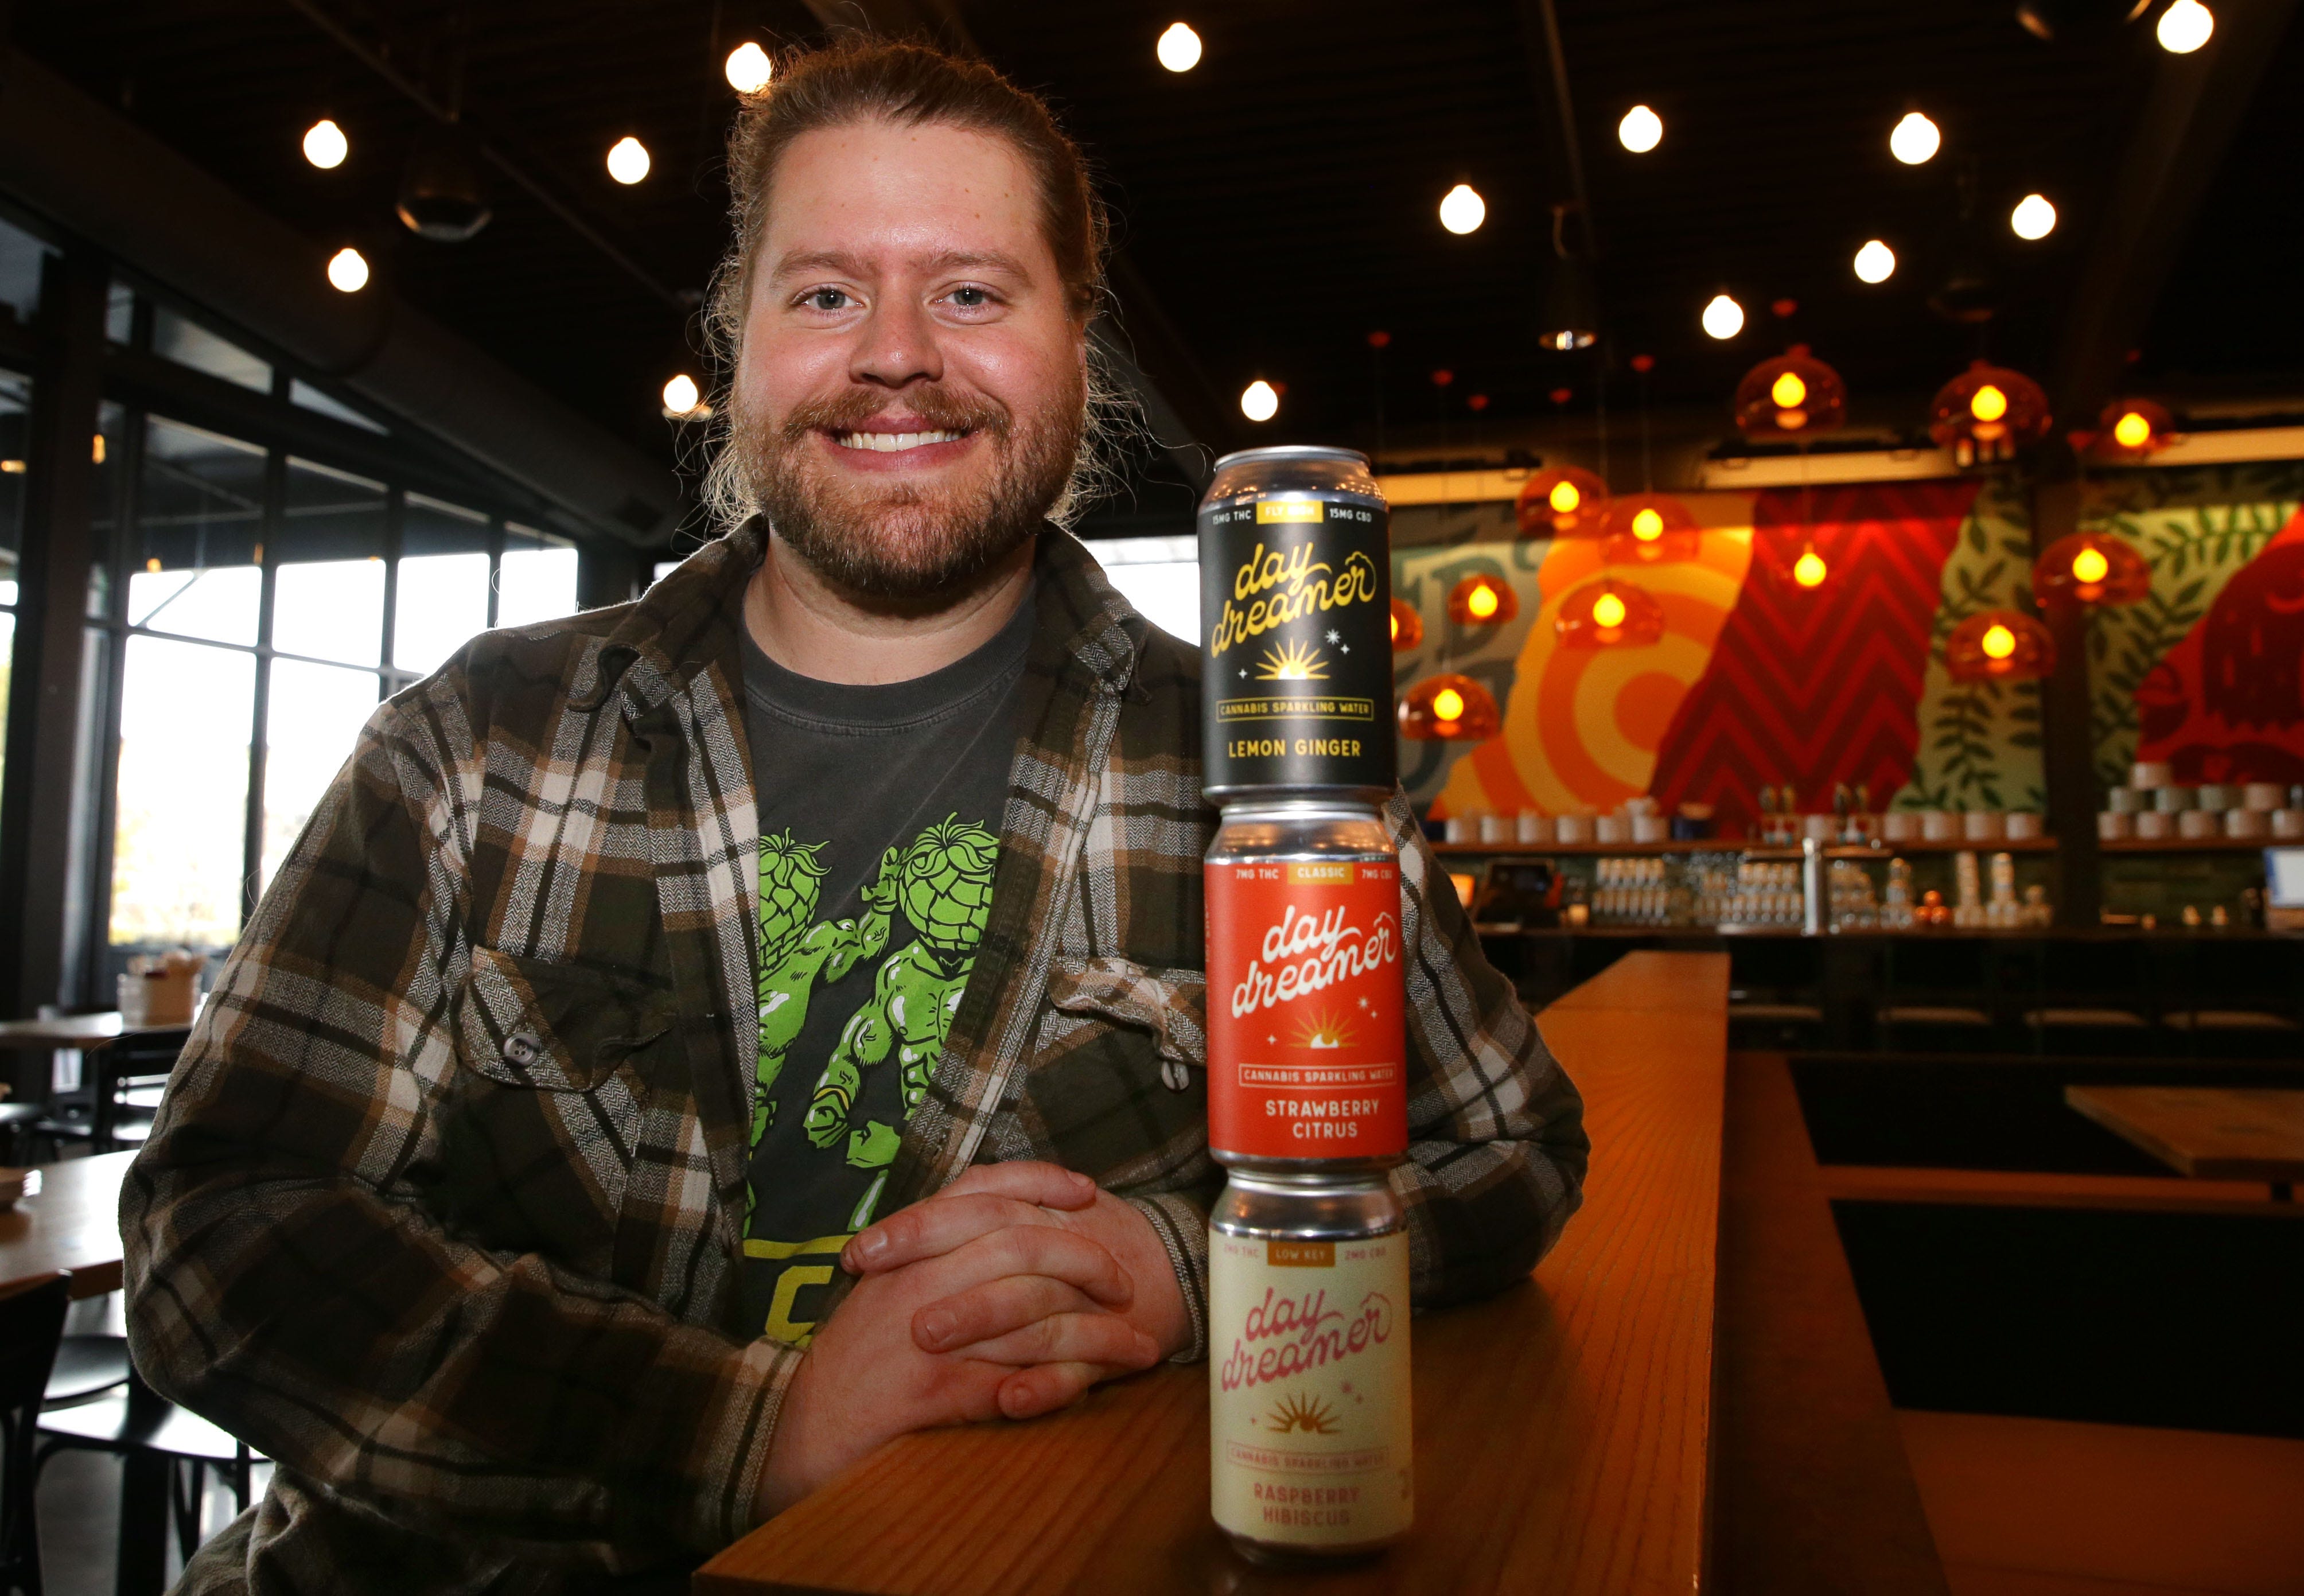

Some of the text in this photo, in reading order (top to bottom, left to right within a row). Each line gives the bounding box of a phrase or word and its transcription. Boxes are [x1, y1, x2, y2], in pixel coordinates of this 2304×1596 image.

[1234, 510, 1251, 521] THC
[1265, 506, 1283, 516] FLY
[1329, 508, 1372, 523] 15MG CBD
[1235, 542, 1332, 601] day
[1211, 551, 1376, 659] dreamer
[1220, 702, 1369, 715] CANNABIS SPARKLING WATER
[1228, 738, 1361, 758] LEMON GINGER
[1236, 869, 1279, 879] 7MG THC
[1297, 866, 1345, 878] CLASSIC
[1262, 905, 1363, 964] day
[1232, 911, 1398, 1019] dreamer
[1244, 1069, 1300, 1083] CANNABIS
[1305, 1071, 1366, 1083] SPARKLING
[1266, 1099, 1380, 1117] STRAWBERRY
[1292, 1122, 1358, 1139] CITRUS
[1275, 1248, 1325, 1260] LOW KEY
[1246, 1287, 1345, 1346] day
[1221, 1291, 1392, 1392] dreamer
[1254, 1482, 1360, 1505] RASPBERRY
[1263, 1506, 1351, 1527] HIBISCUS
